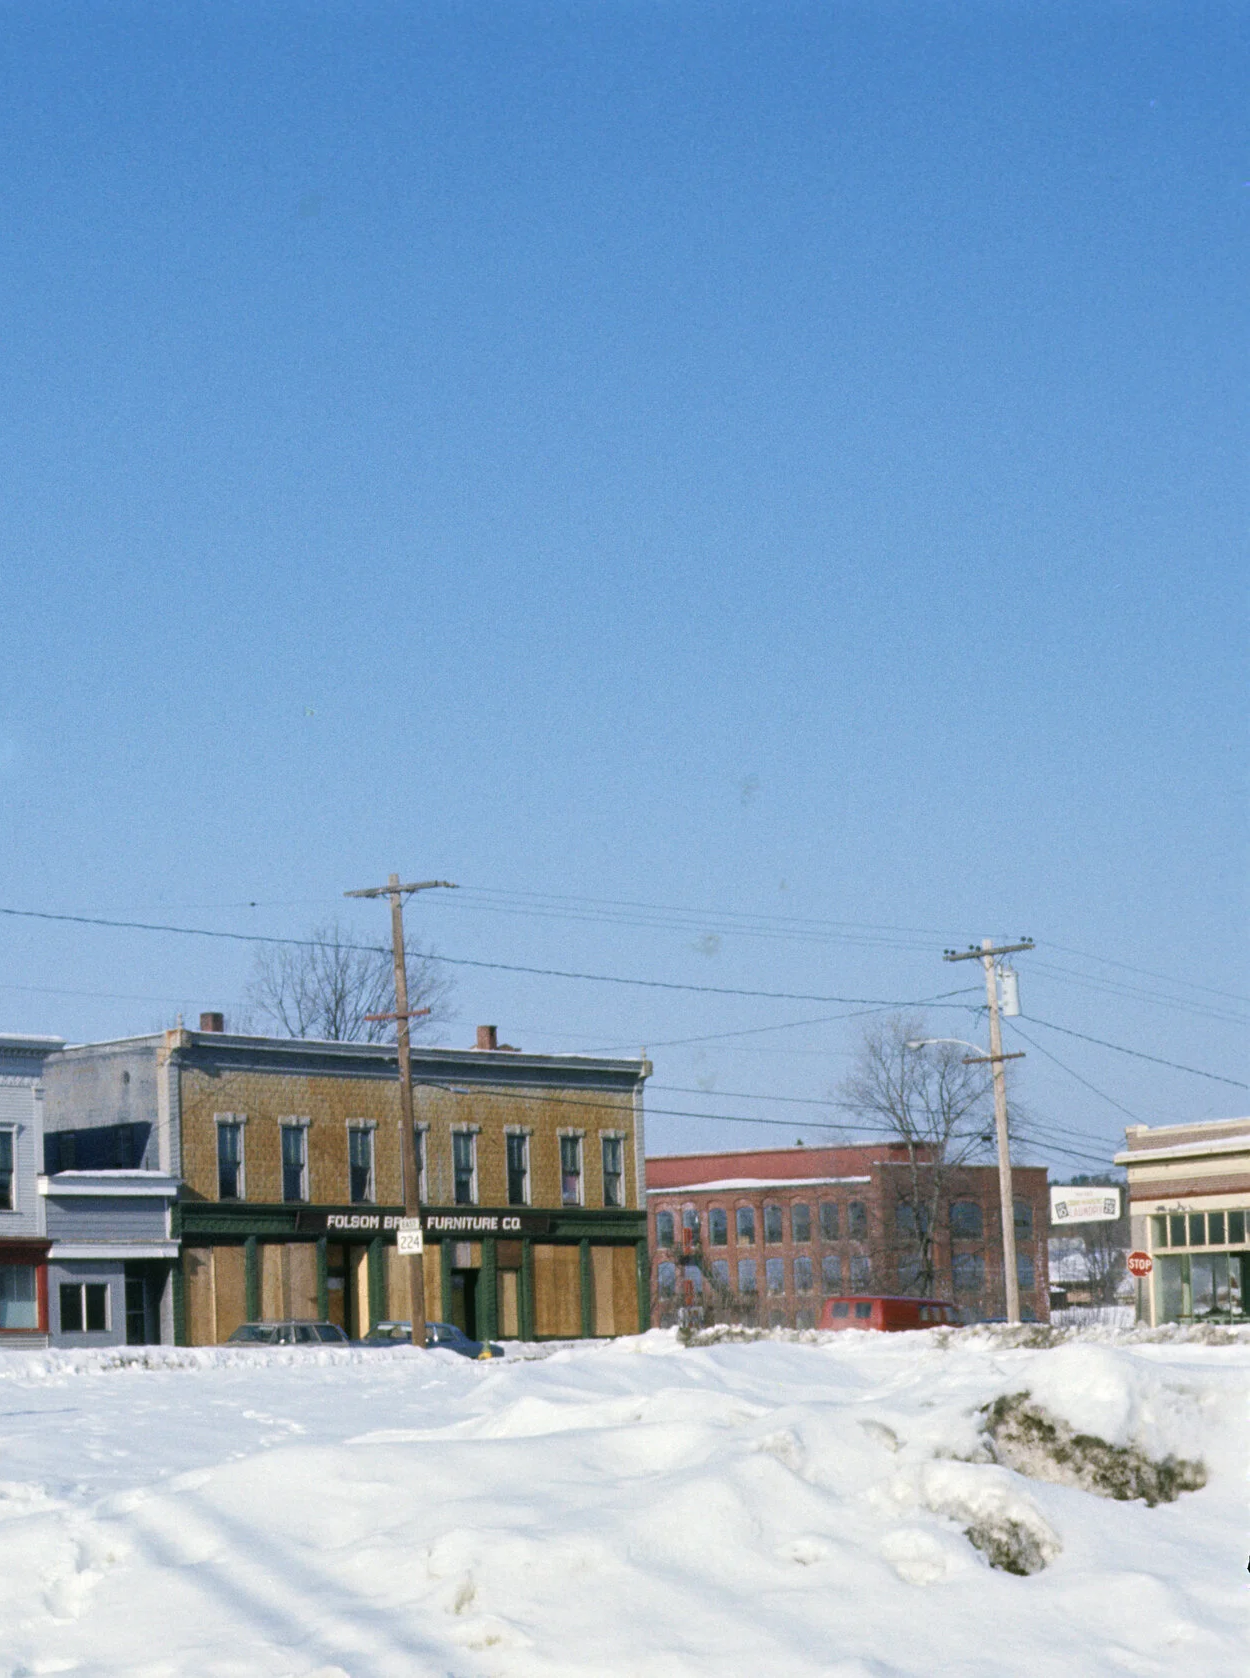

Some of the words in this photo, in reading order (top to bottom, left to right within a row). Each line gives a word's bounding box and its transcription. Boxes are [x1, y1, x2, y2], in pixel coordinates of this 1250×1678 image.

[327, 1215, 379, 1229] FOLSOM
[427, 1216, 498, 1230] FURNITURE
[400, 1235, 420, 1250] 224
[1128, 1258, 1152, 1269] STOP
